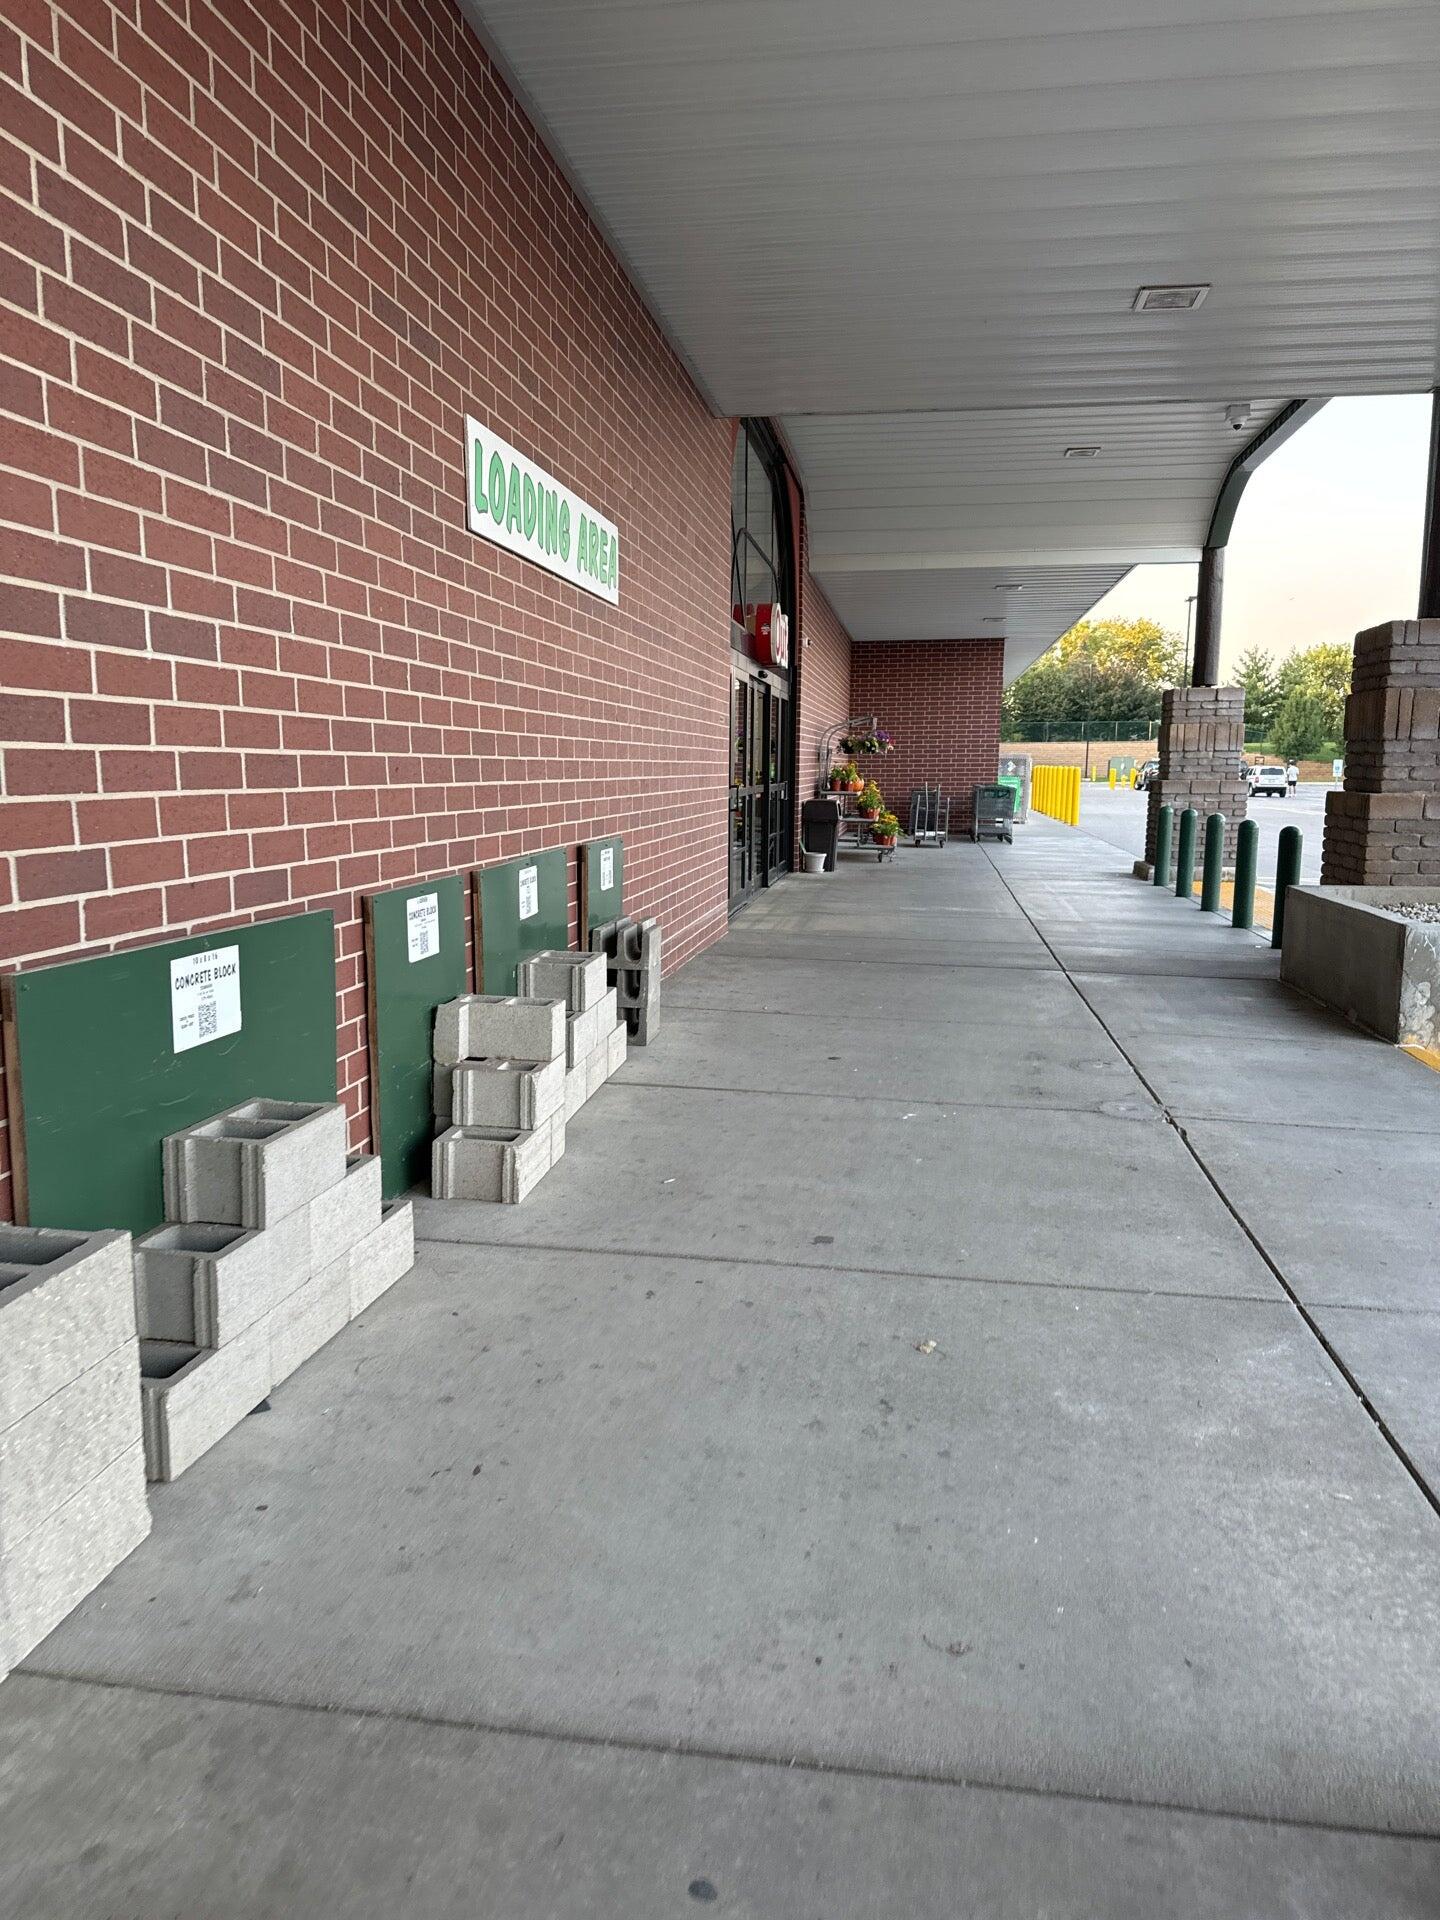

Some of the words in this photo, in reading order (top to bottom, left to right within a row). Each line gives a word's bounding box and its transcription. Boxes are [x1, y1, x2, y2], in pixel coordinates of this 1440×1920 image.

[474, 438, 571, 563] LOADING
[576, 512, 617, 591] AREA
[175, 970, 211, 990] CONCRETE
[214, 963, 236, 979] BLOCK
